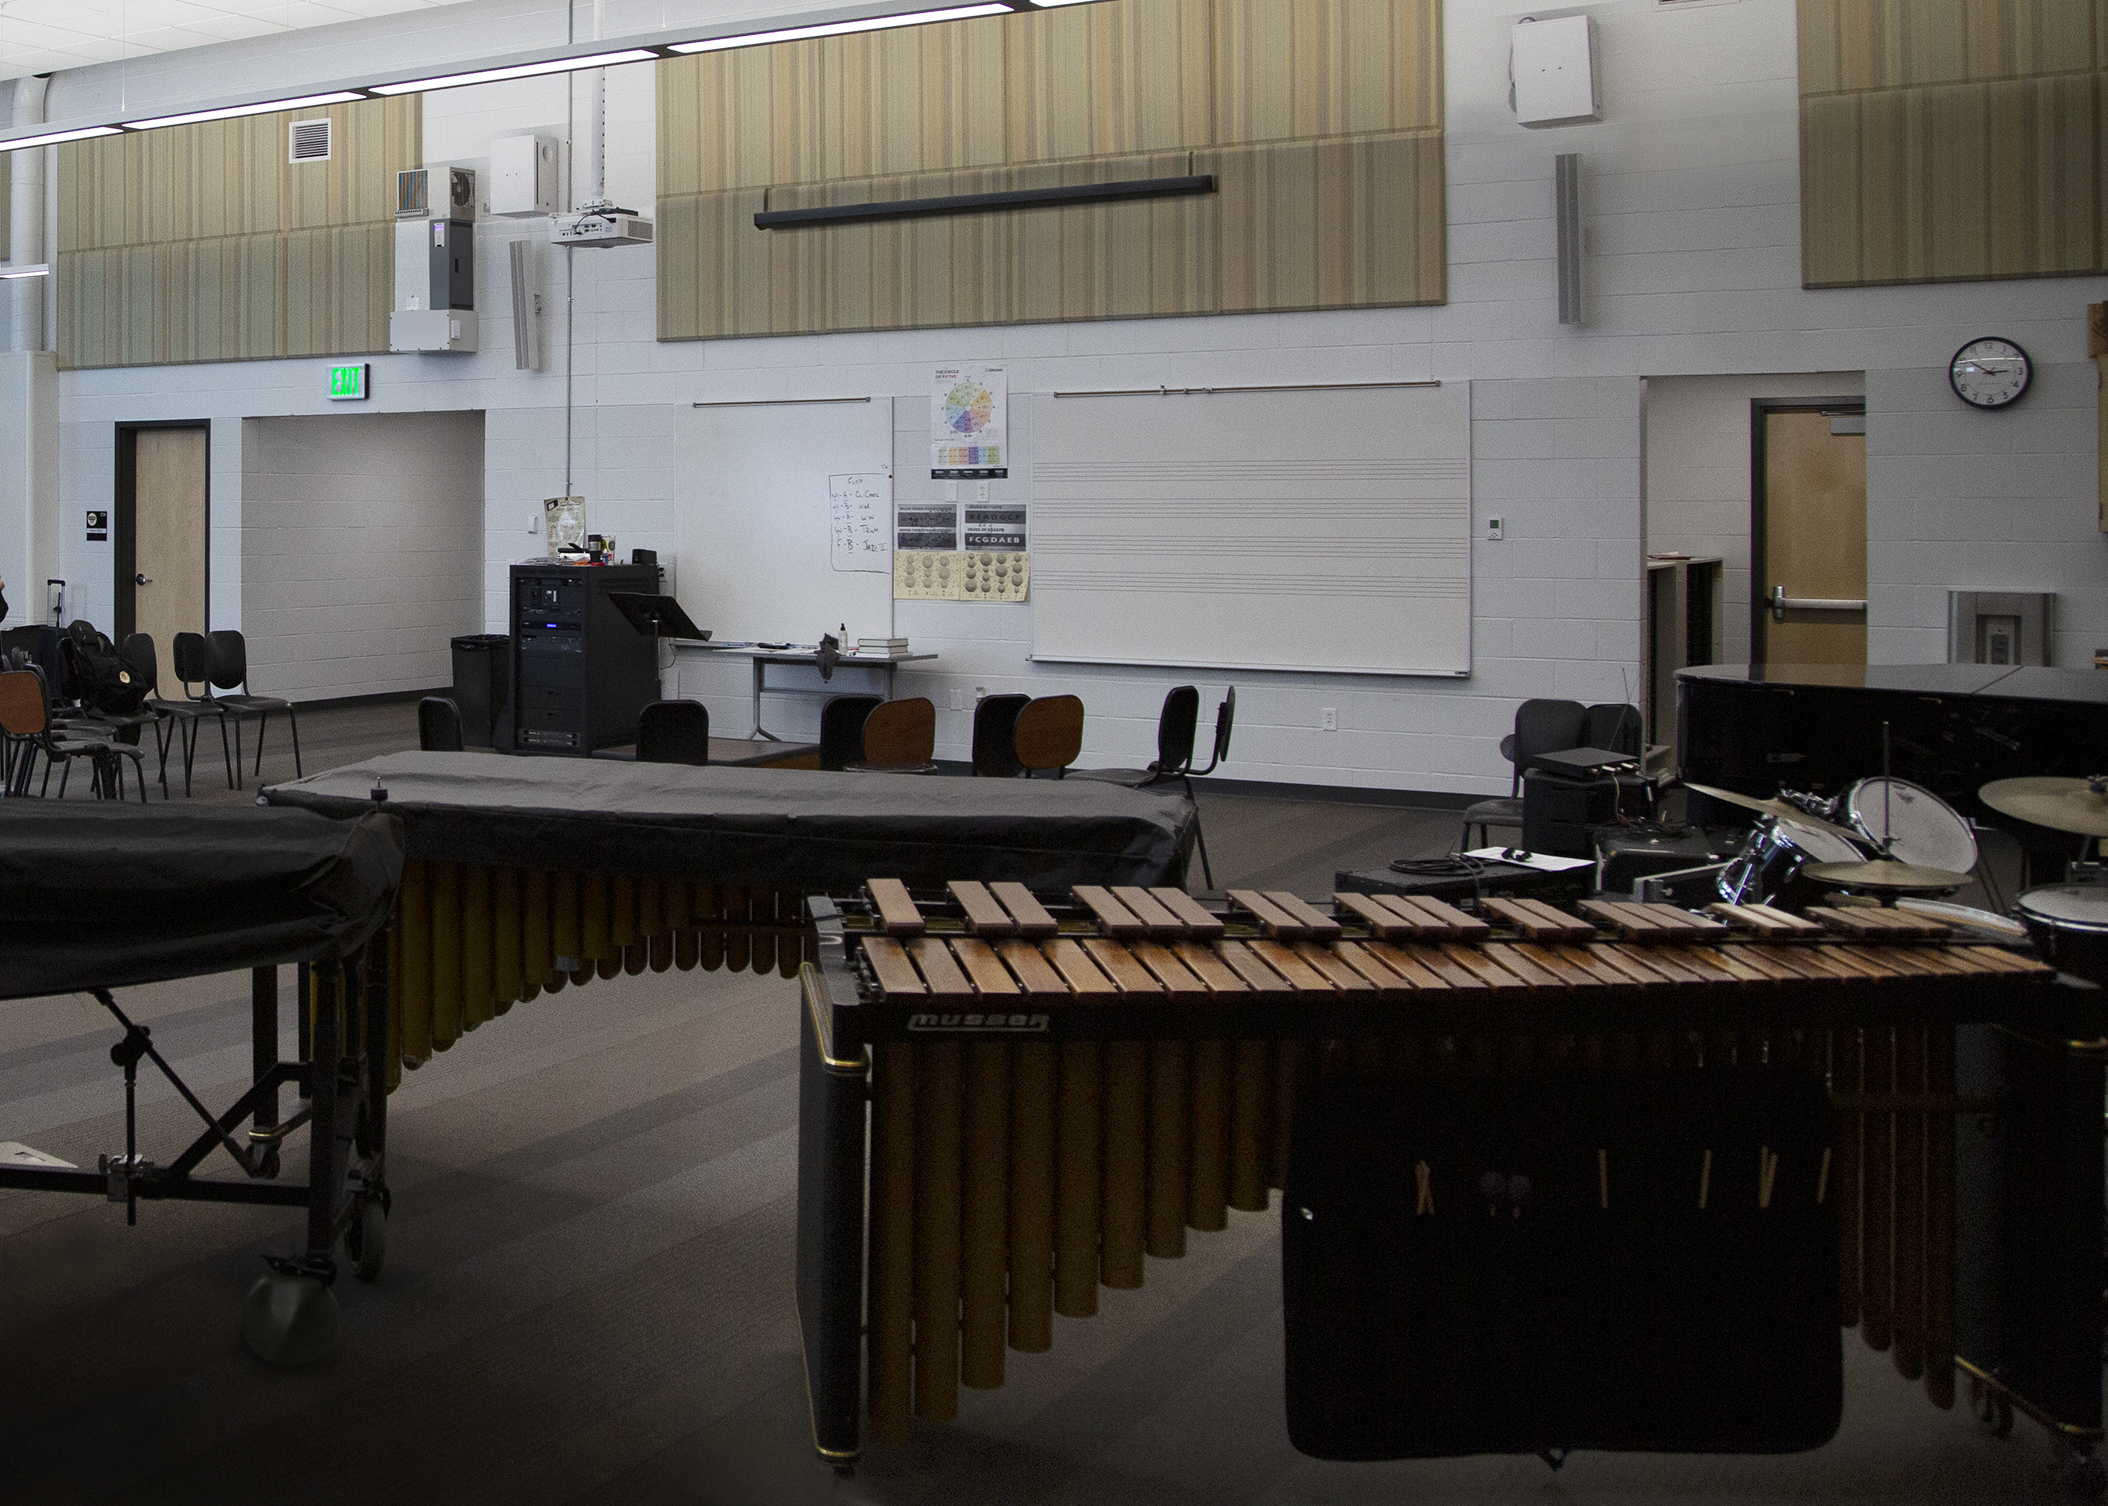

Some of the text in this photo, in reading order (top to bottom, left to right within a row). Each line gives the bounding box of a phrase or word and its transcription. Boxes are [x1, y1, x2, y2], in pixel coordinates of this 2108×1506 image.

[2018, 367, 2023, 376] 3
[331, 367, 361, 396] EXIT
[1960, 383, 1967, 392] 8
[1987, 395, 1994, 404] 6
[2002, 391, 2009, 399] 5
